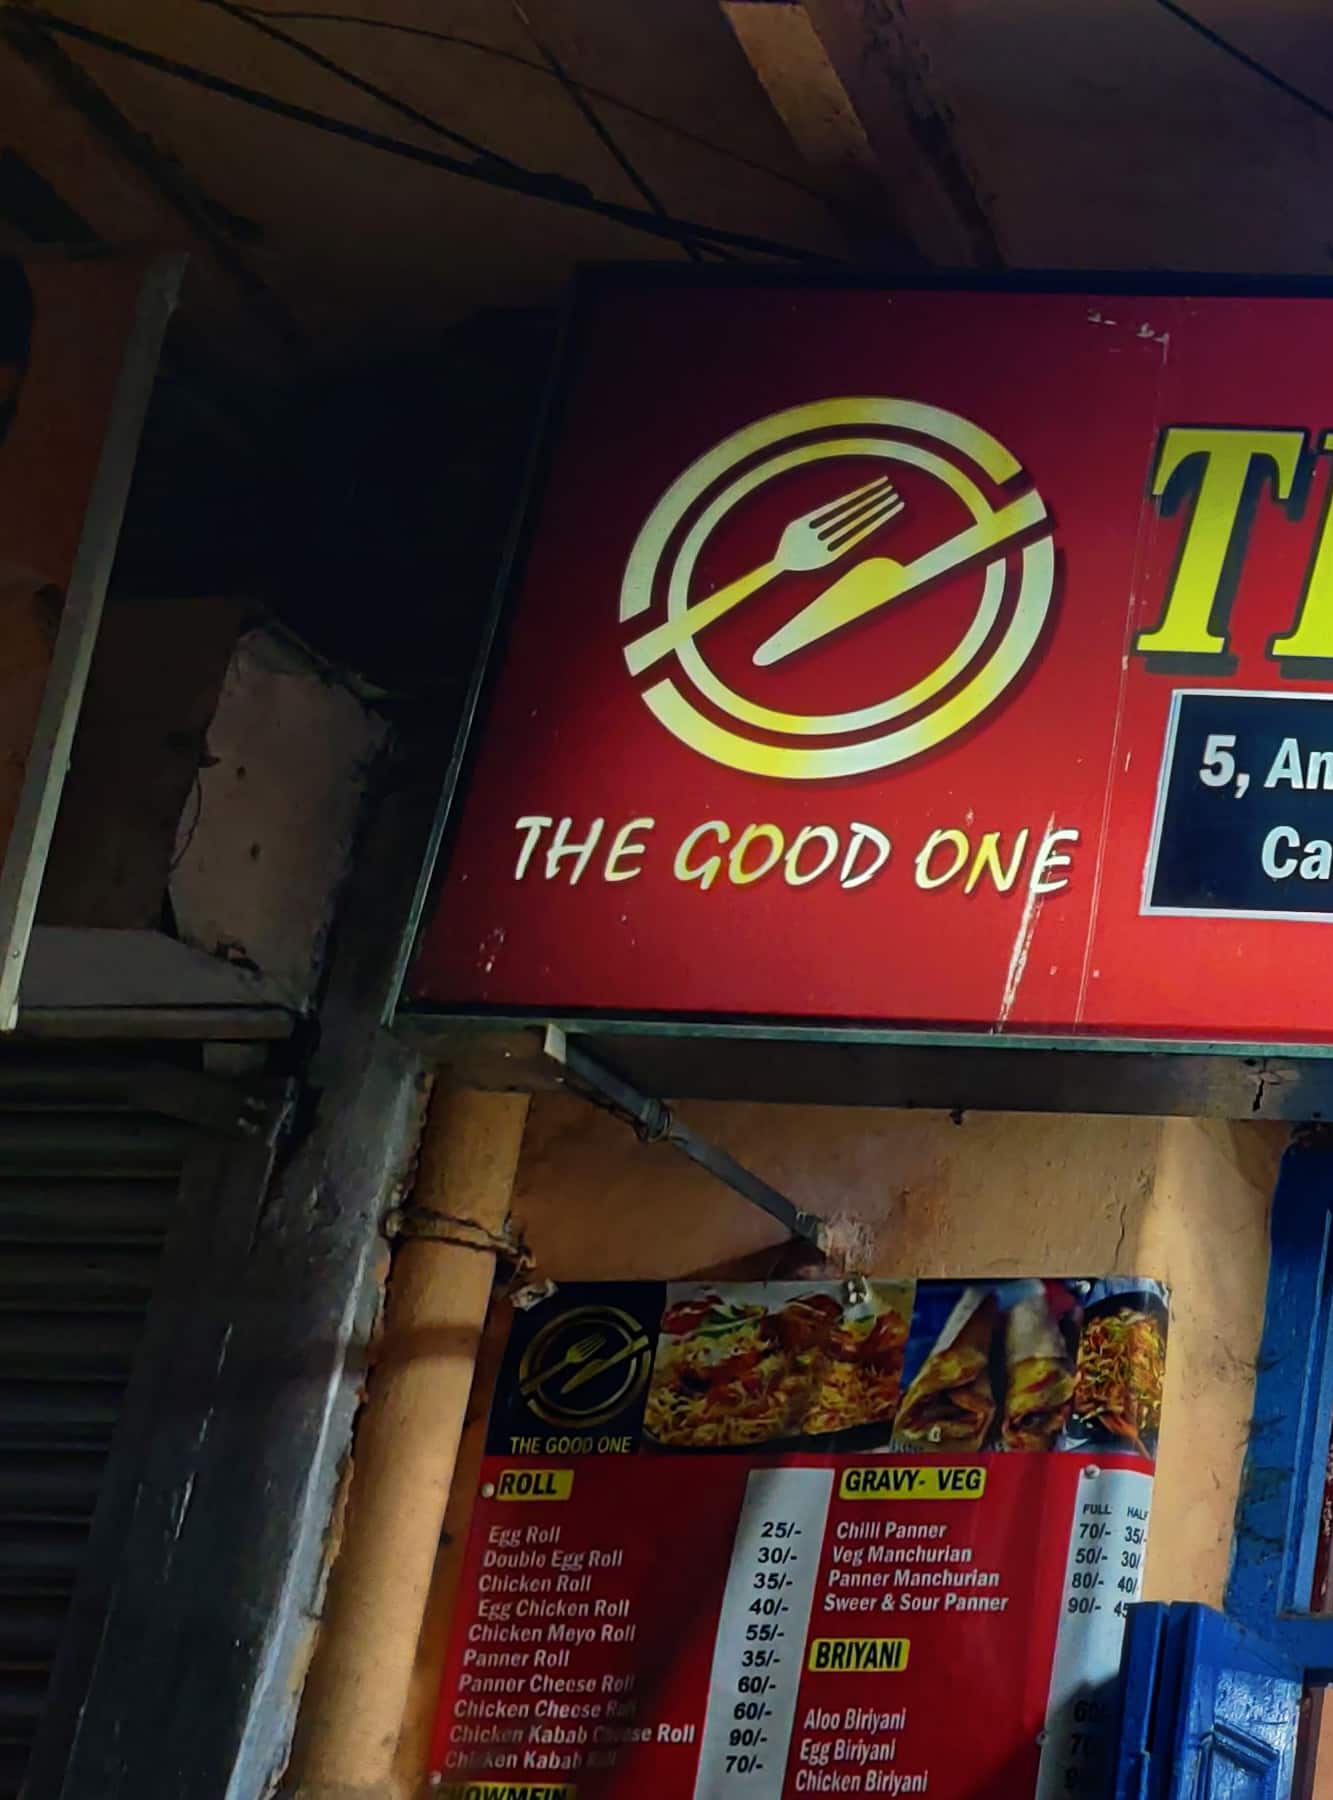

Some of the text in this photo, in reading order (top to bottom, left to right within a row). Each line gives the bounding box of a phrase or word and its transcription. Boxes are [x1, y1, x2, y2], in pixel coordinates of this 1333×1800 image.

[1199, 733, 1251, 799] 5,
[514, 816, 1079, 894] THE GOOD ONE
[510, 1435, 633, 1454] THE GOOD ONE
[500, 1473, 557, 1495] ROLL
[845, 1469, 981, 1492] GRAVY- VEG
[1082, 1503, 1112, 1515] FULL
[488, 1526, 561, 1547] Egg Roll
[761, 1522, 802, 1539] 25/-
[836, 1521, 947, 1539] Chilli Panner
[1079, 1523, 1112, 1539] 70/-
[483, 1550, 624, 1571] Double Egg Roll
[757, 1547, 798, 1564] 30/-
[832, 1546, 972, 1566] Veg Manchurian
[1075, 1547, 1108, 1564] 50/-
[478, 1574, 592, 1592] Chicken Roll
[753, 1573, 793, 1590] 35/-
[828, 1569, 1000, 1587] Panner Manchurian
[1071, 1572, 1104, 1589] 80/-
[477, 1599, 630, 1620] Egg Chicken Roll
[749, 1598, 789, 1615] 40/-
[881, 1594, 895, 1611] &
[899, 1594, 940, 1612] Sour
[944, 1594, 1009, 1611] Panner
[1067, 1597, 1100, 1614] 90/-
[467, 1624, 636, 1646] Chicken Meyo Roll
[746, 1624, 784, 1641] 55/-
[463, 1649, 570, 1667] Panner Roll
[742, 1650, 780, 1668] 35/-
[815, 1641, 903, 1669] BRIYANI
[458, 1673, 526, 1693] Panner
[529, 1673, 597, 1693] Cheese
[737, 1675, 776, 1694] 60/-
[453, 1699, 529, 1718] Chicken
[534, 1699, 602, 1718] Cheese
[733, 1702, 772, 1721] 60/-
[803, 1707, 907, 1734] Aloo Biriyani
[449, 1724, 524, 1744] Chicken
[527, 1725, 588, 1744] Kabab
[656, 1723, 696, 1743] Roll
[729, 1728, 768, 1747] 90/-
[523, 1751, 582, 1769] Kabab
[800, 1738, 896, 1766] Egg Biriyani
[725, 1755, 763, 1774] 70/-
[795, 1769, 928, 1797] Chicken Biriyani
